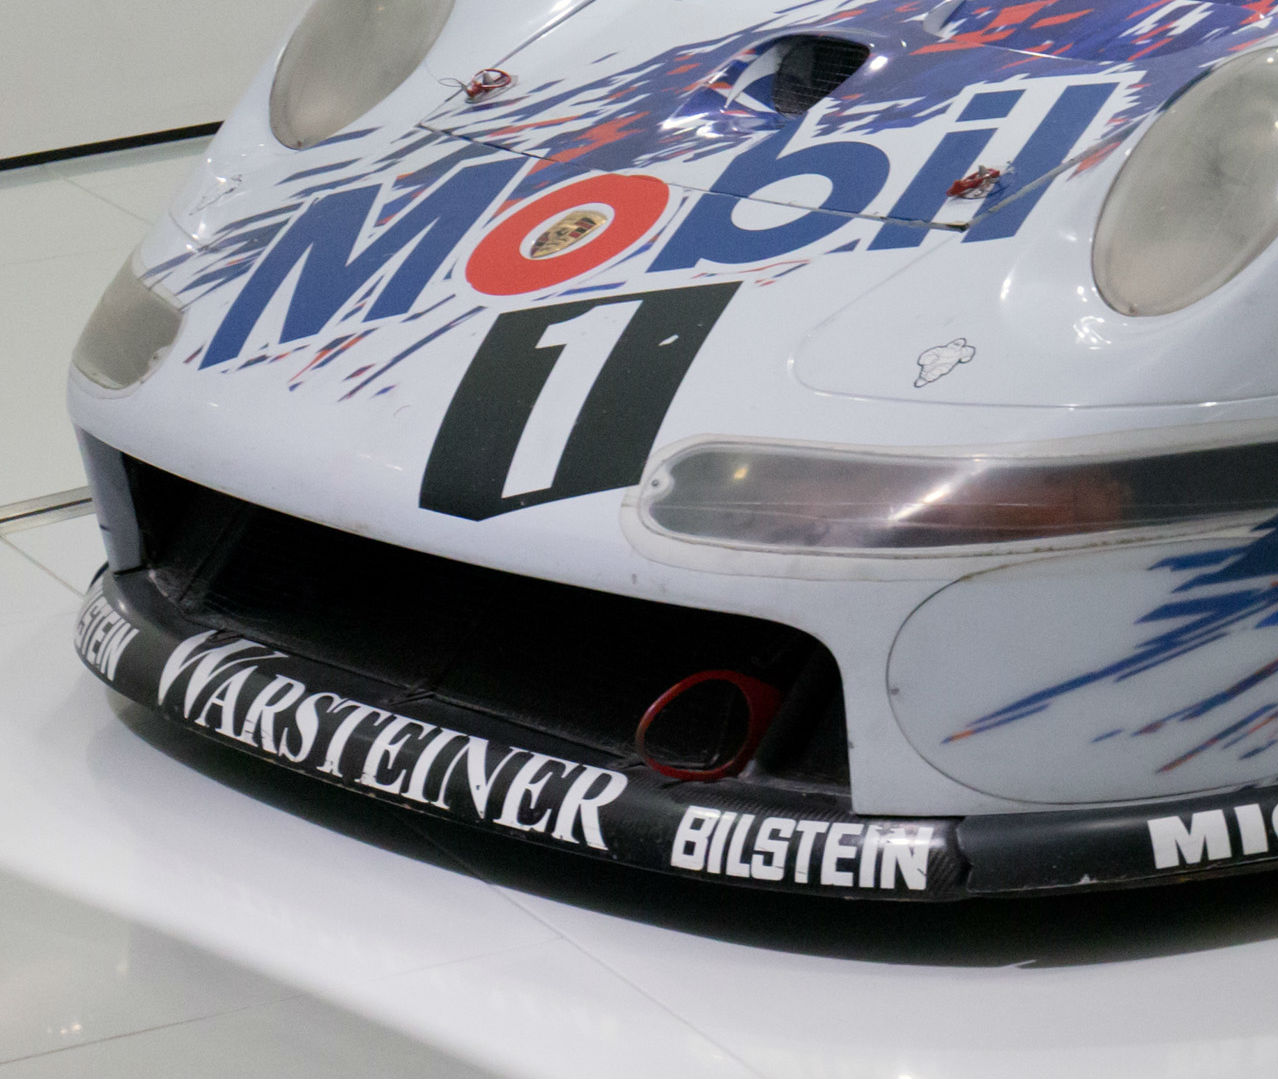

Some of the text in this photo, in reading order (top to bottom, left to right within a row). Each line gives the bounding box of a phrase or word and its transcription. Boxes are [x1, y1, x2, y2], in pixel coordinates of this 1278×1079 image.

[199, 81, 1121, 370] Mobil
[157, 629, 629, 851] WARSTEINER
[670, 804, 935, 890] BILSTEIN
